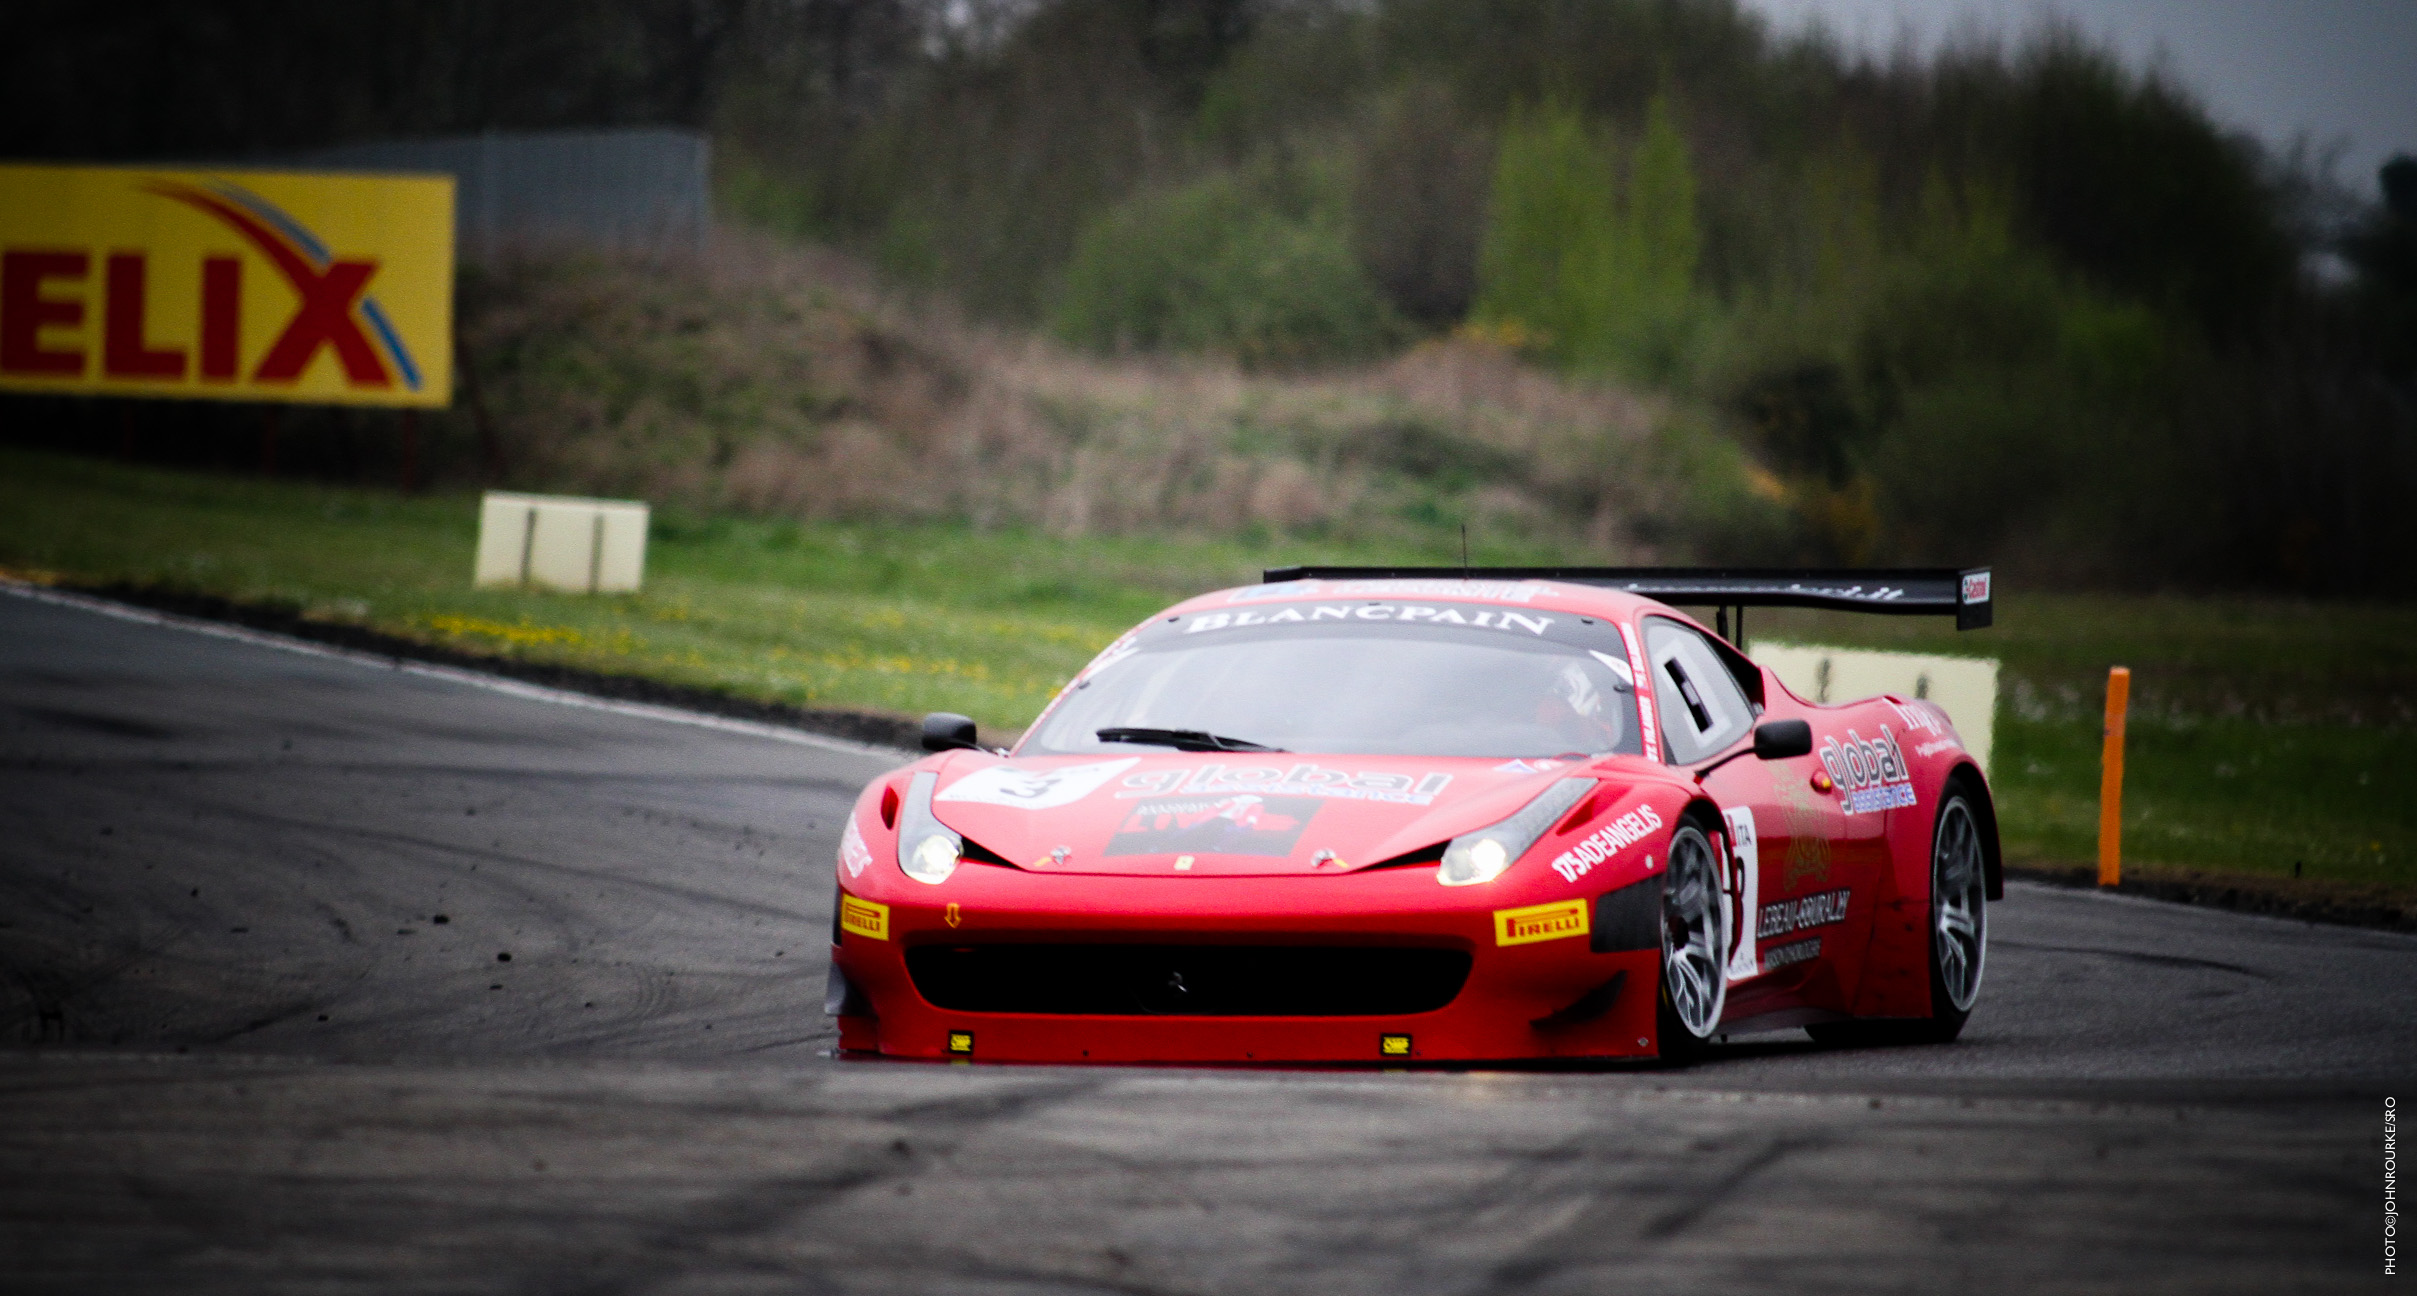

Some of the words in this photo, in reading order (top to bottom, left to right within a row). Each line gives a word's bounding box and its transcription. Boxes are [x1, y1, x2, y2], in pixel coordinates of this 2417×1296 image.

[1183, 604, 1555, 636] BLANCPAIN
[1113, 763, 1454, 799] global
[1819, 723, 1909, 815] global
[1506, 908, 1580, 937] PIRELLI
